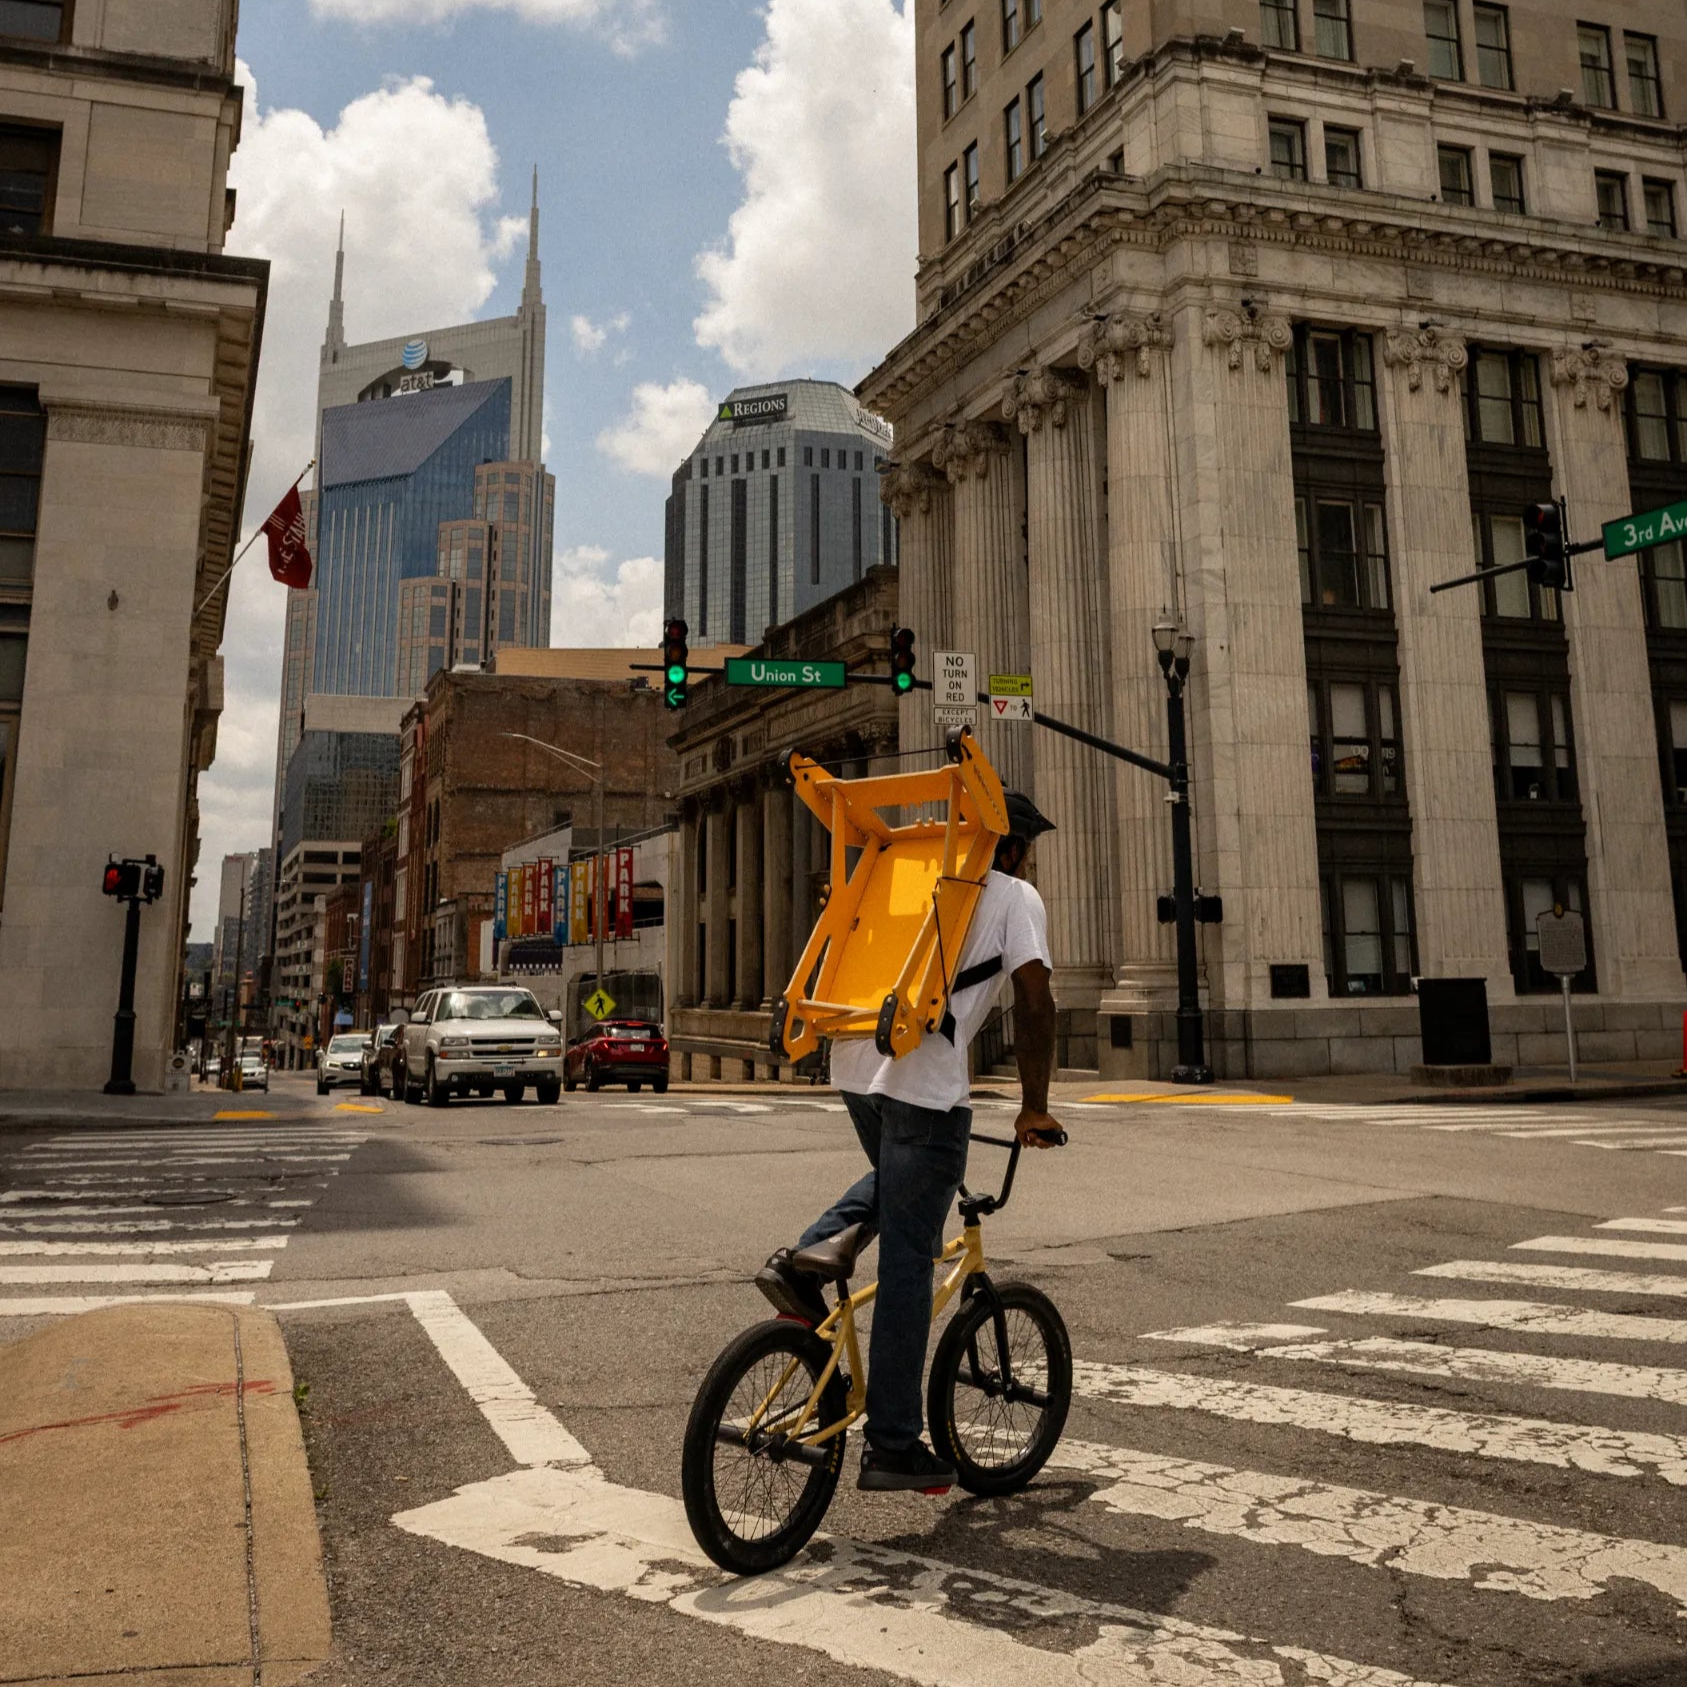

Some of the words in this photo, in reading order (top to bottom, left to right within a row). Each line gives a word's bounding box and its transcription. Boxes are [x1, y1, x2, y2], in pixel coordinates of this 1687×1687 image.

[401, 372, 432, 392] at&t
[1623, 523, 1654, 547] 3rd
[1659, 511, 1687, 537] Av
[750, 663, 797, 682] Union
[801, 665, 822, 683] St
[943, 669, 968, 678] TURN
[946, 656, 964, 667] NO
[946, 692, 965, 702] RED
[948, 681, 962, 690] ON
[938, 716, 973, 724] BICYCLES
[511, 872, 519, 918] PARK
[524, 867, 534, 915] PARK
[540, 862, 550, 912] PARK
[557, 871, 566, 923] PARK
[575, 866, 585, 920] PARK
[619, 852, 630, 913] PARK
[498, 877, 506, 920] PARK
[345, 960, 353, 986] PARK
